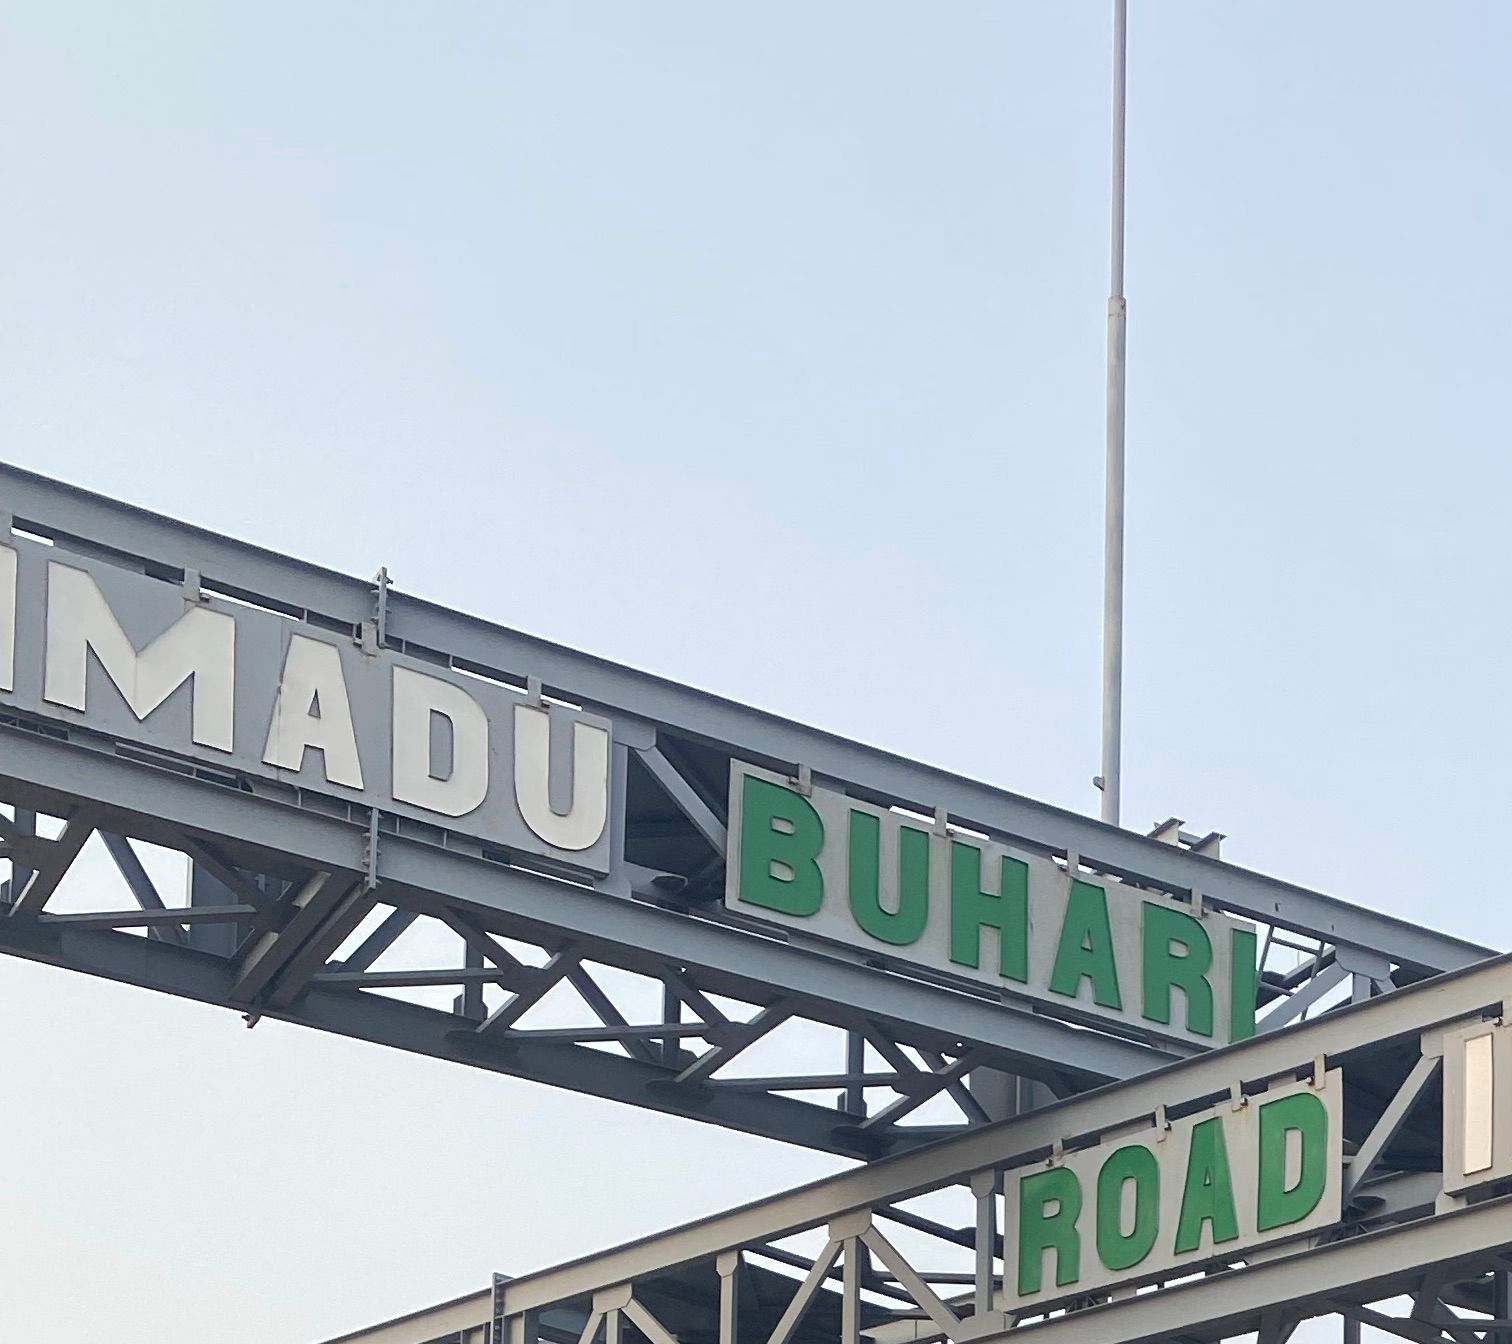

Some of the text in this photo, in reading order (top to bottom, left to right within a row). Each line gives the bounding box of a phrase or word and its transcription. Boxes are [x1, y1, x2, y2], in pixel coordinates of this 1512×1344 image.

[0, 545, 1257, 1043] MADU BUHARI
[1018, 1092, 1328, 1297] ROAD
